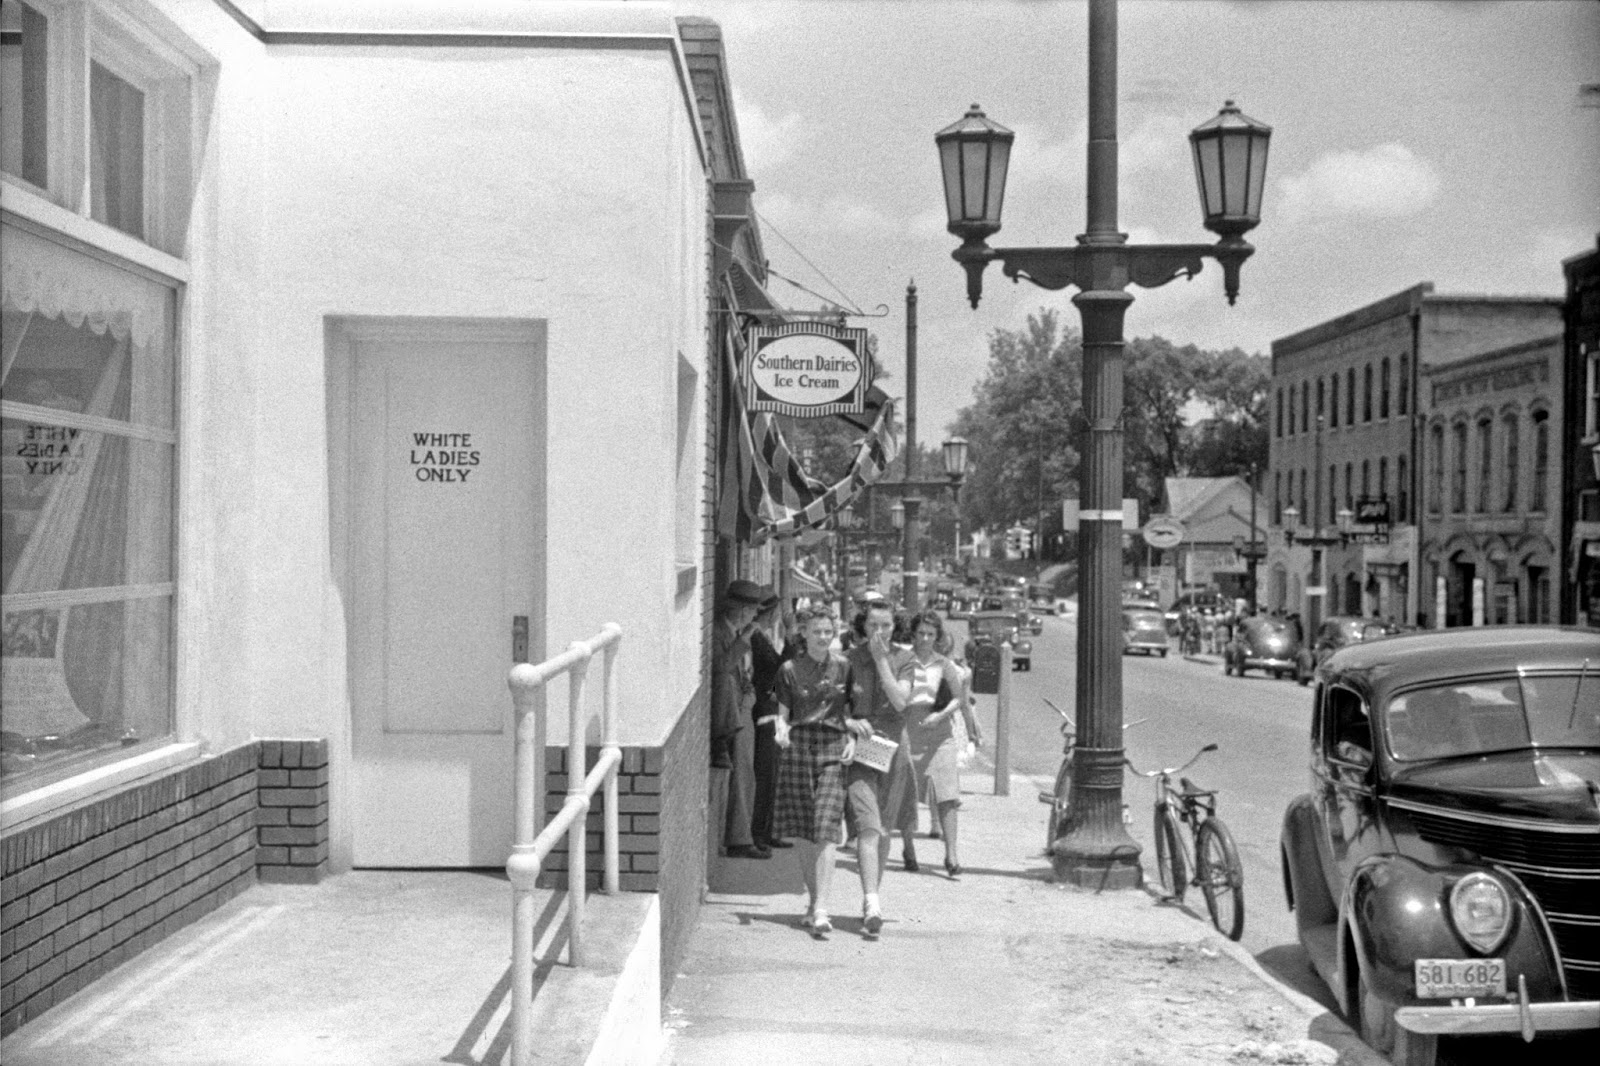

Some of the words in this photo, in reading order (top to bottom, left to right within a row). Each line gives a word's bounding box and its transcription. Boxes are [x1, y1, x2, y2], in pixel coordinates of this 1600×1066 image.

[757, 354, 813, 370] Southern
[815, 355, 857, 372] Dairies
[774, 373, 793, 387] Ice
[798, 374, 839, 388] Cream
[413, 433, 472, 447] WHITE
[411, 450, 480, 465] LADIES
[416, 467, 472, 482] ONLY
